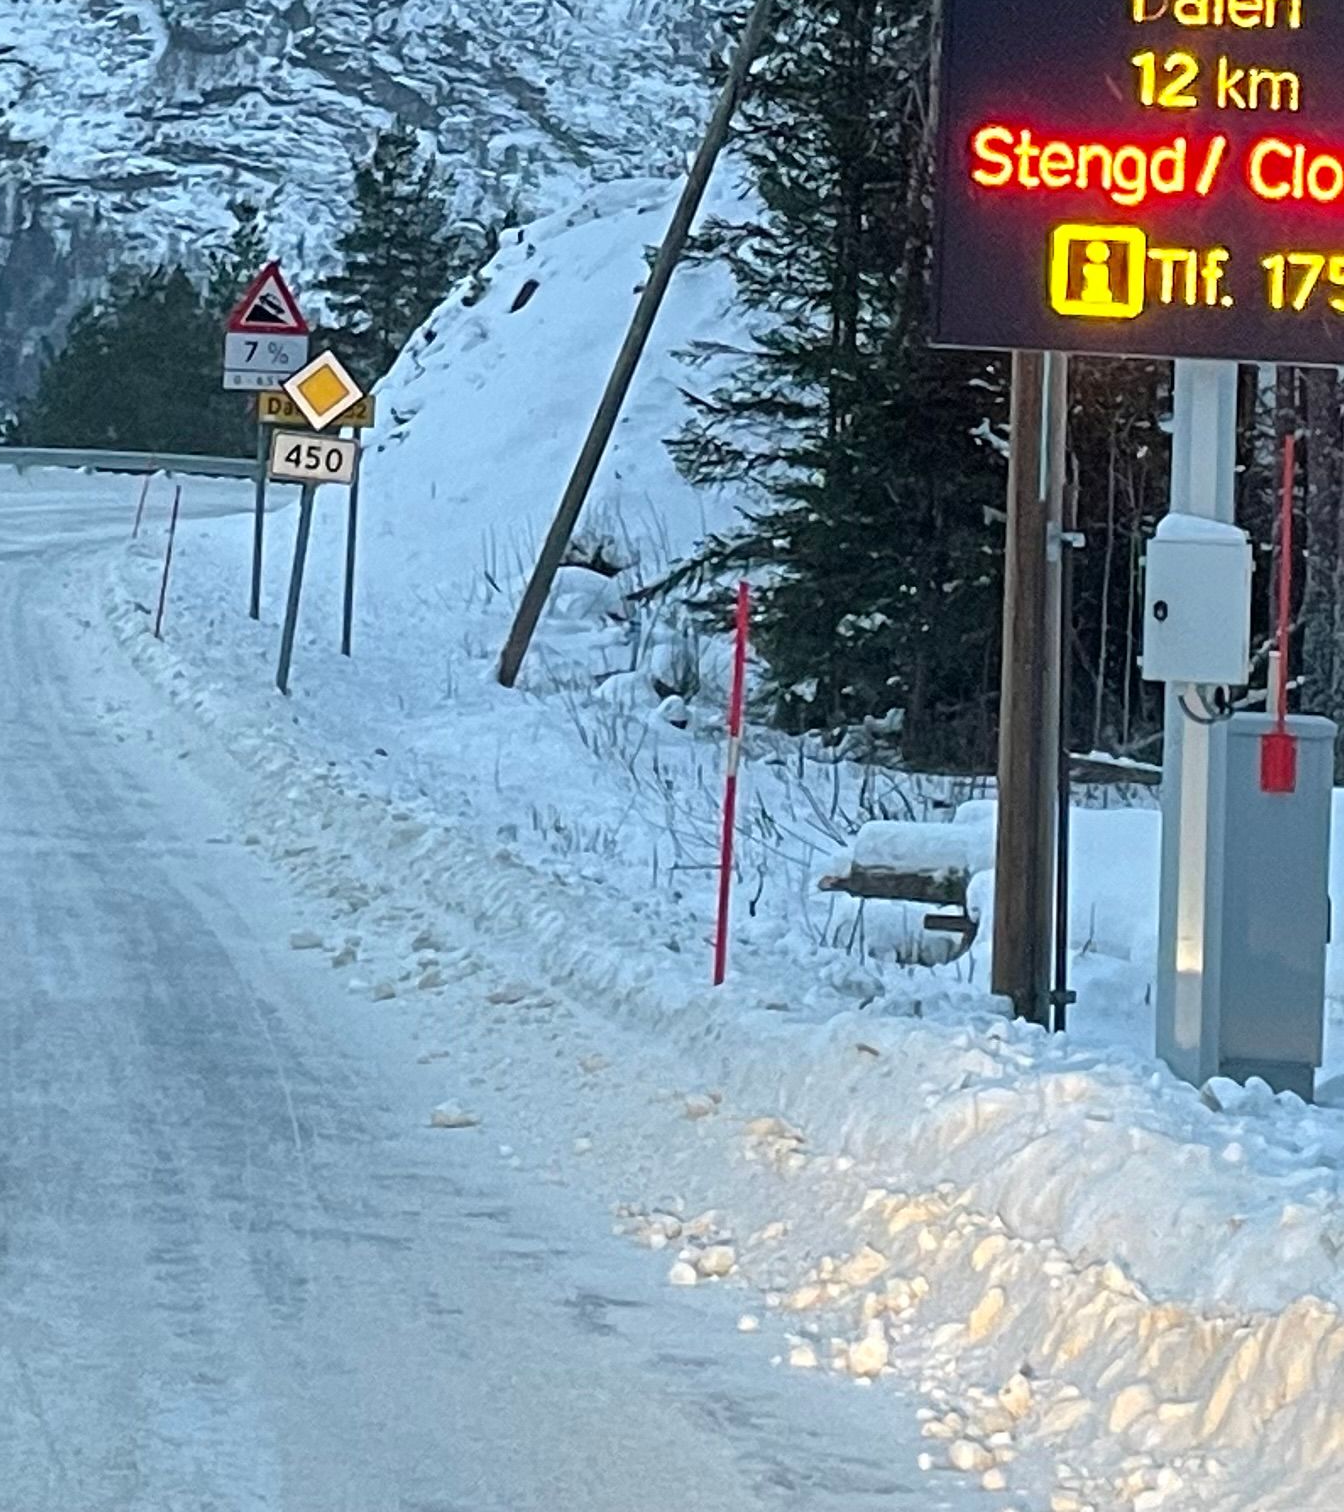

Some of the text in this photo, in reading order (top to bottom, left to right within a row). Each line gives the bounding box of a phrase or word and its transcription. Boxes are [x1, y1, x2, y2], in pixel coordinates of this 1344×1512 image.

[1131, 51, 1300, 112] 12 km
[1147, 246, 1234, 308] Tlf.
[244, 341, 289, 364] 7 %
[285, 444, 343, 473] 450
